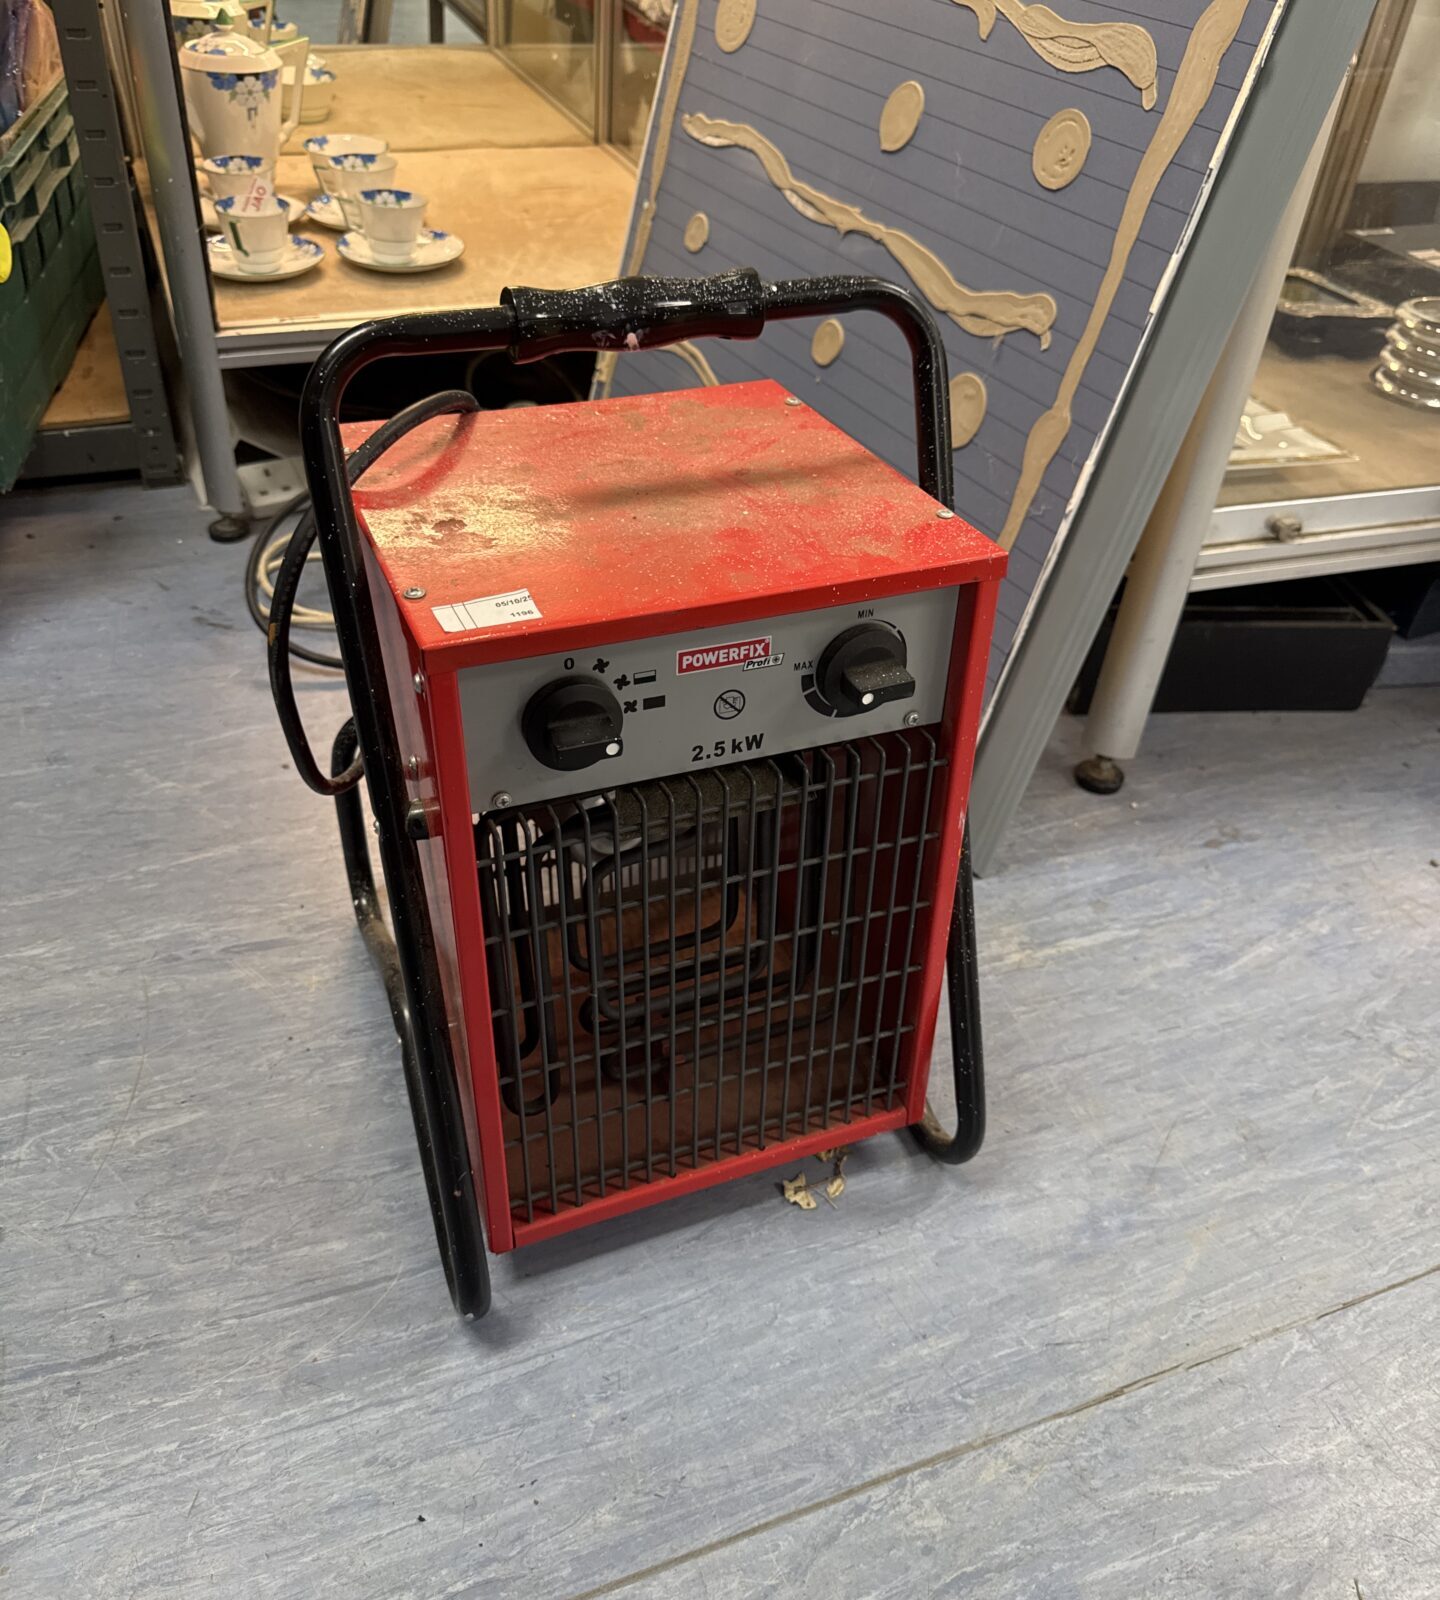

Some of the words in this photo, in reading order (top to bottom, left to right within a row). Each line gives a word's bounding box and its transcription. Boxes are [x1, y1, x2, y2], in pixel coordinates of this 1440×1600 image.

[858, 608, 874, 618] MIN
[682, 642, 765, 669] POWERFIX
[745, 657, 770, 669] Profi
[794, 660, 813, 671] MAX
[691, 740, 725, 762] 2.5
[732, 733, 764, 754] kW
